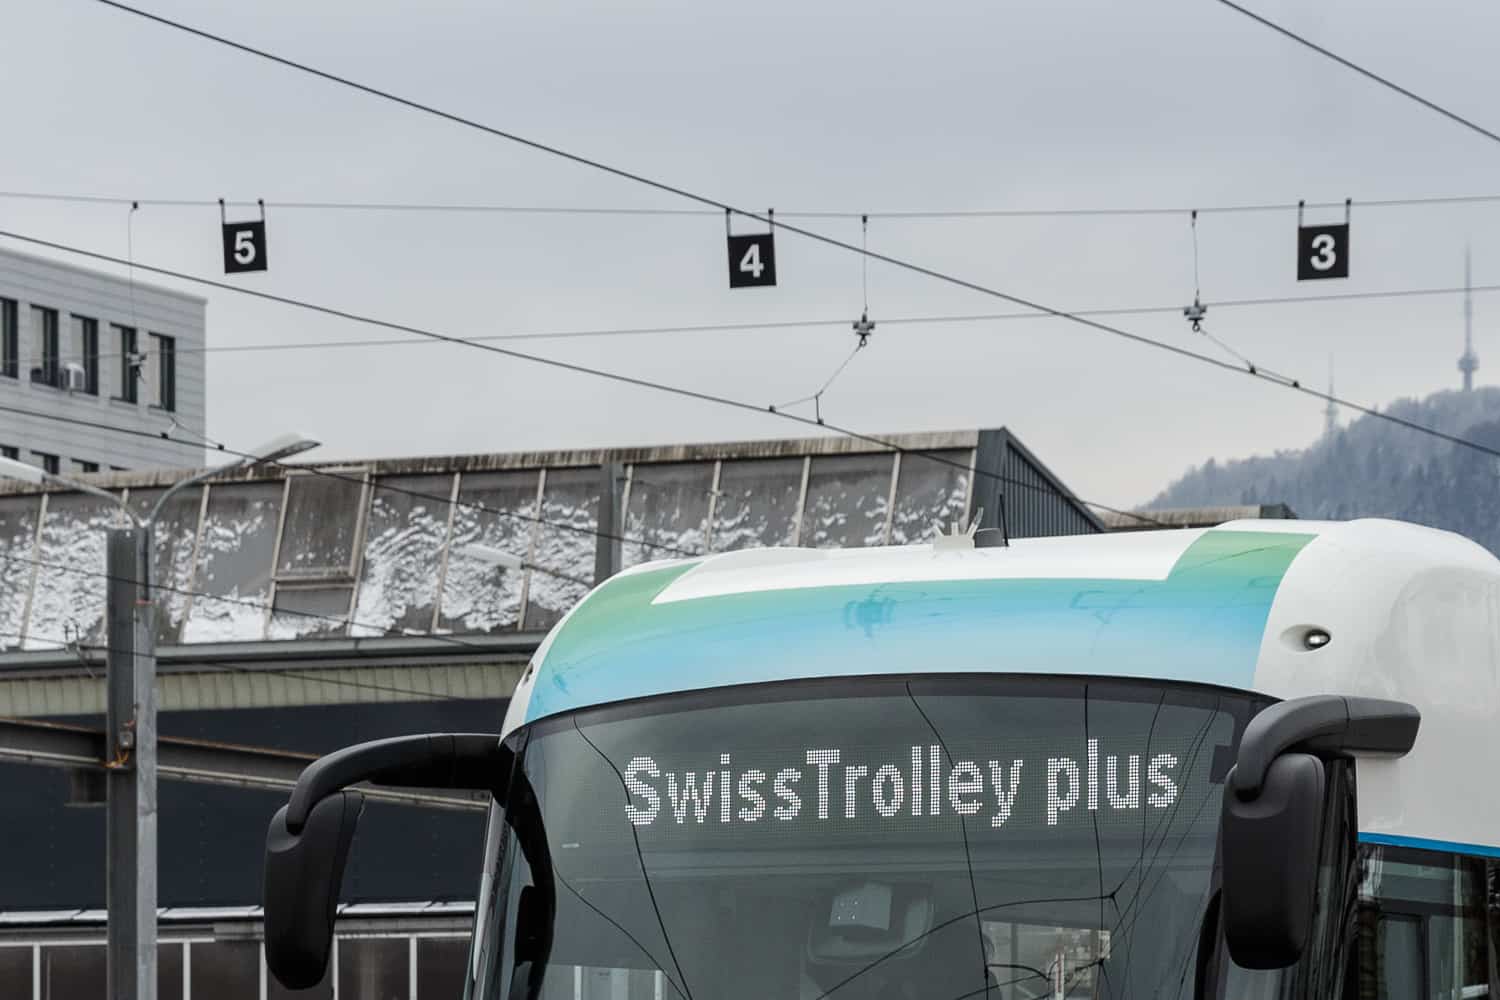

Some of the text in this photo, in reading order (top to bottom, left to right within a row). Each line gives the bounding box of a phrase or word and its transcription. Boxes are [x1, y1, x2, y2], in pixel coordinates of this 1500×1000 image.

[233, 231, 256, 265] 5
[739, 243, 764, 278] 4
[1310, 234, 1336, 271] 3
[624, 738, 1178, 828] SwissTrolley plus
